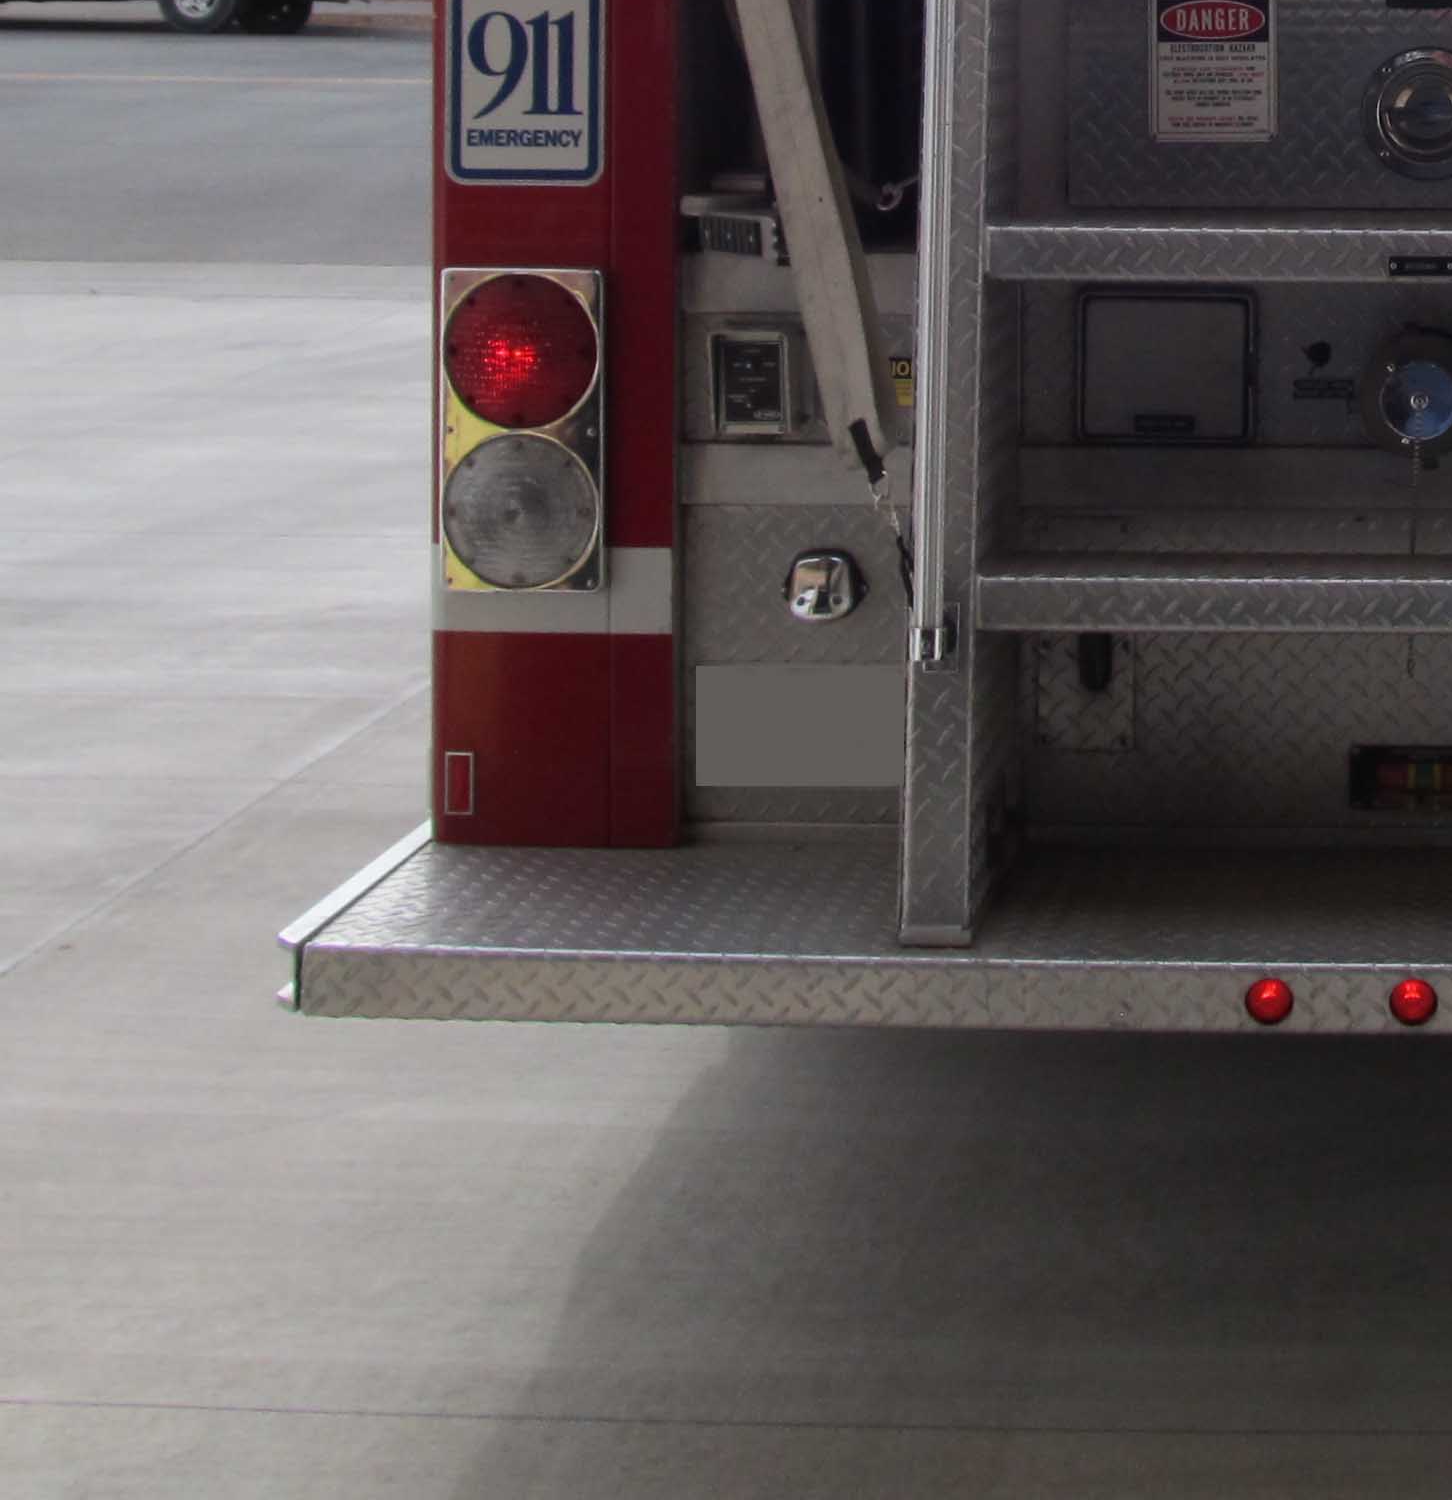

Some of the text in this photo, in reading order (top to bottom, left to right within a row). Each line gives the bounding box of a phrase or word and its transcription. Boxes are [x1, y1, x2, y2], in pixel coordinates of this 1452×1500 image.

[1175, 8, 1250, 31] DANGER
[467, 10, 584, 119] 911
[466, 129, 582, 147] EMERGENCY
